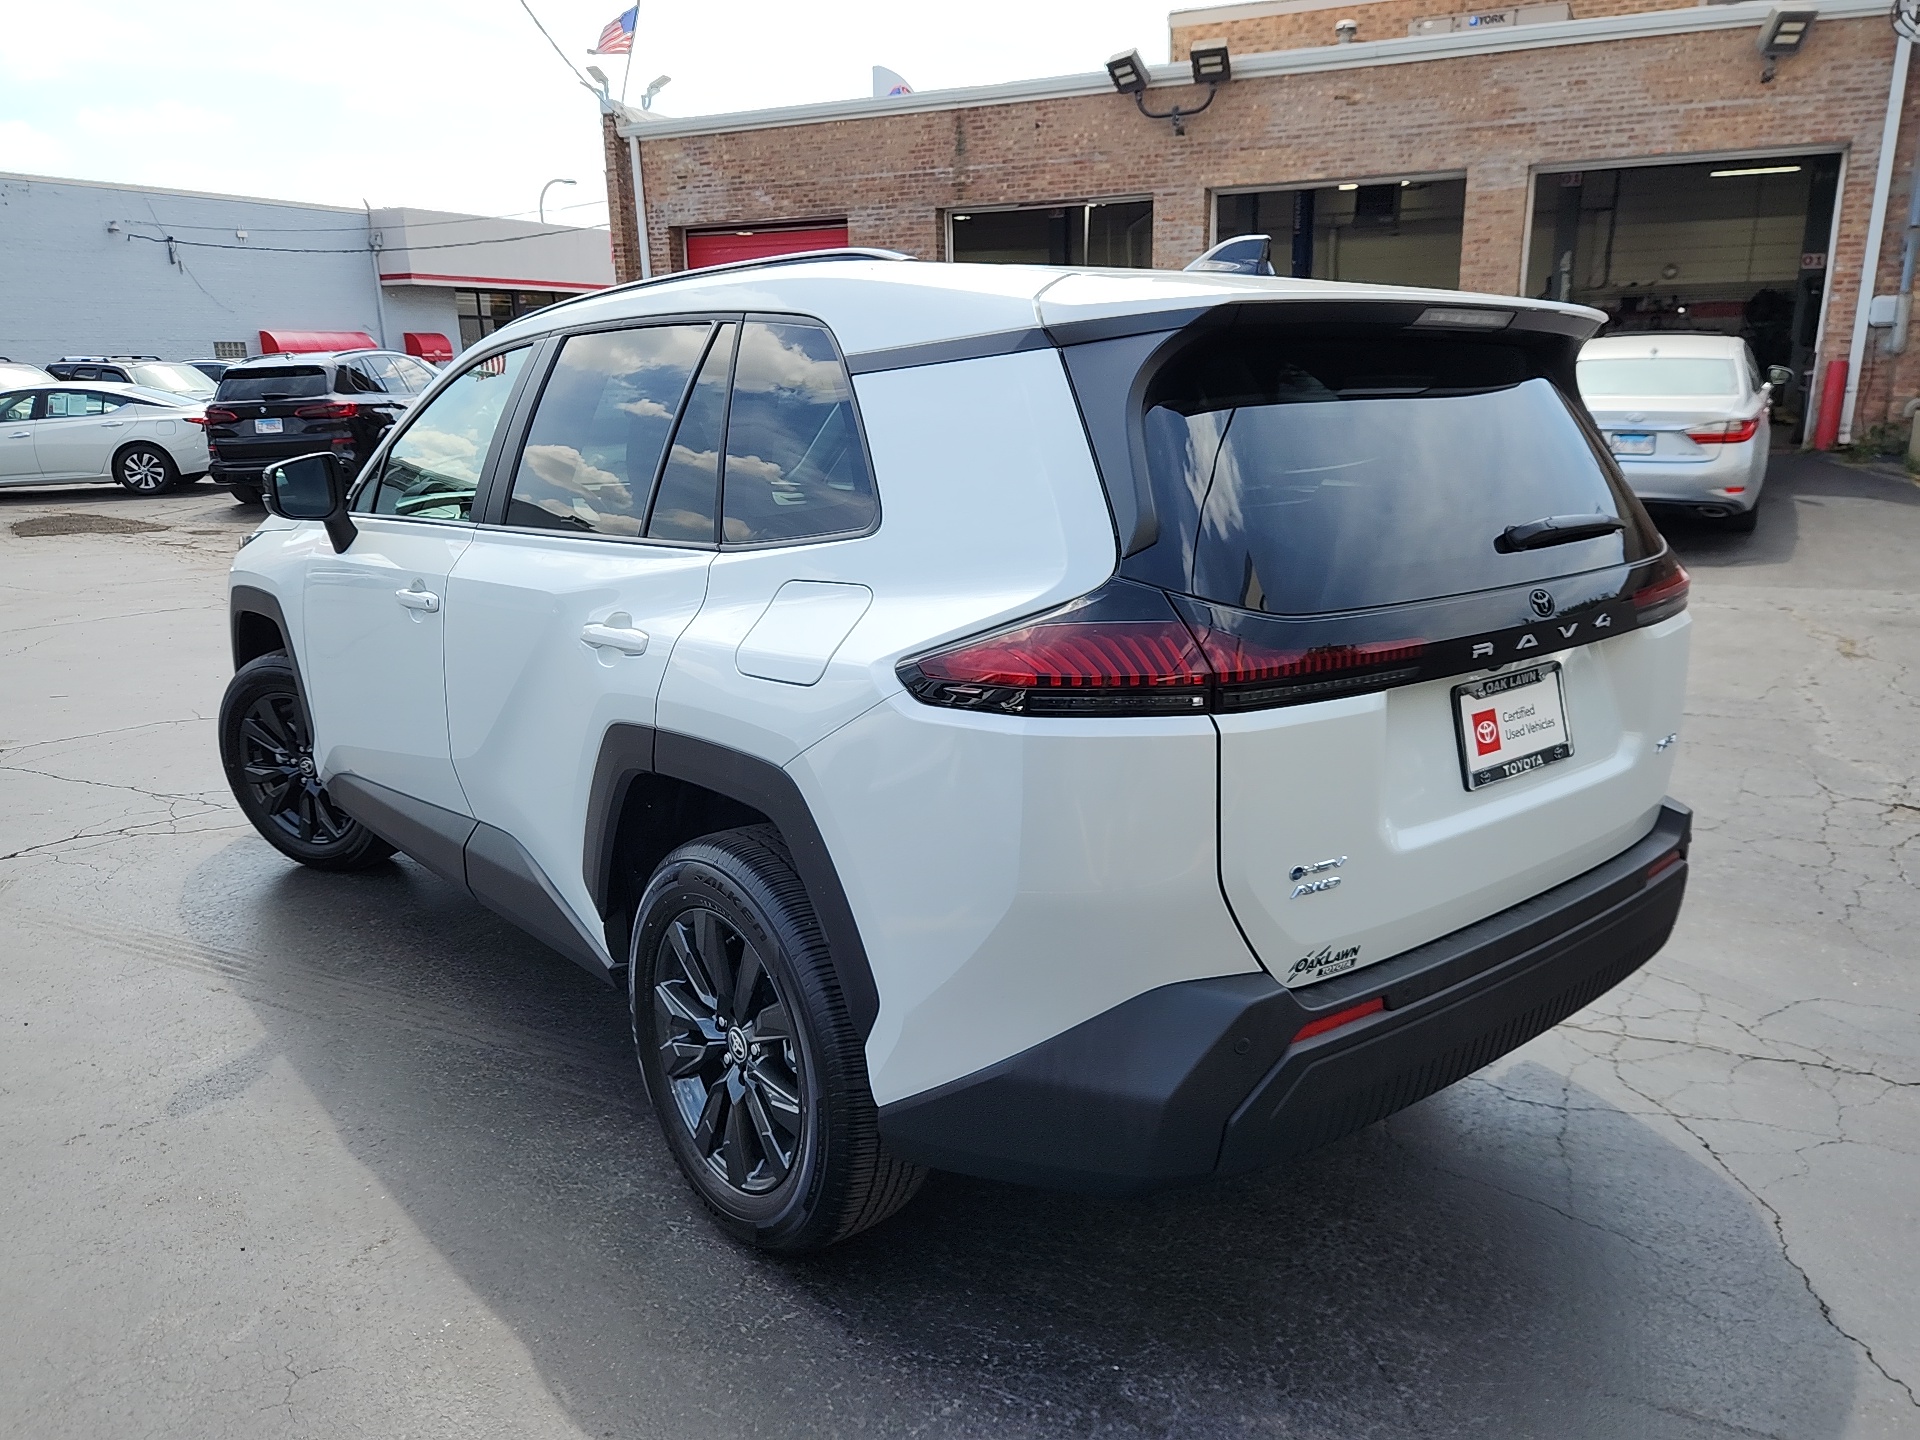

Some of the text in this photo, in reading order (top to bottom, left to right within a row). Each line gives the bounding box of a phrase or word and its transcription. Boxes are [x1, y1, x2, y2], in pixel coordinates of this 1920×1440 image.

[1479, 13, 1506, 26] YORK
[1471, 612, 1612, 659] RAV4
[1485, 670, 1537, 694] OAK LAWN
[1502, 703, 1536, 723] Certified
[1505, 717, 1556, 741] Used Vehicles
[1502, 754, 1544, 776] TOYOTA
[1289, 876, 1342, 900] AWD
